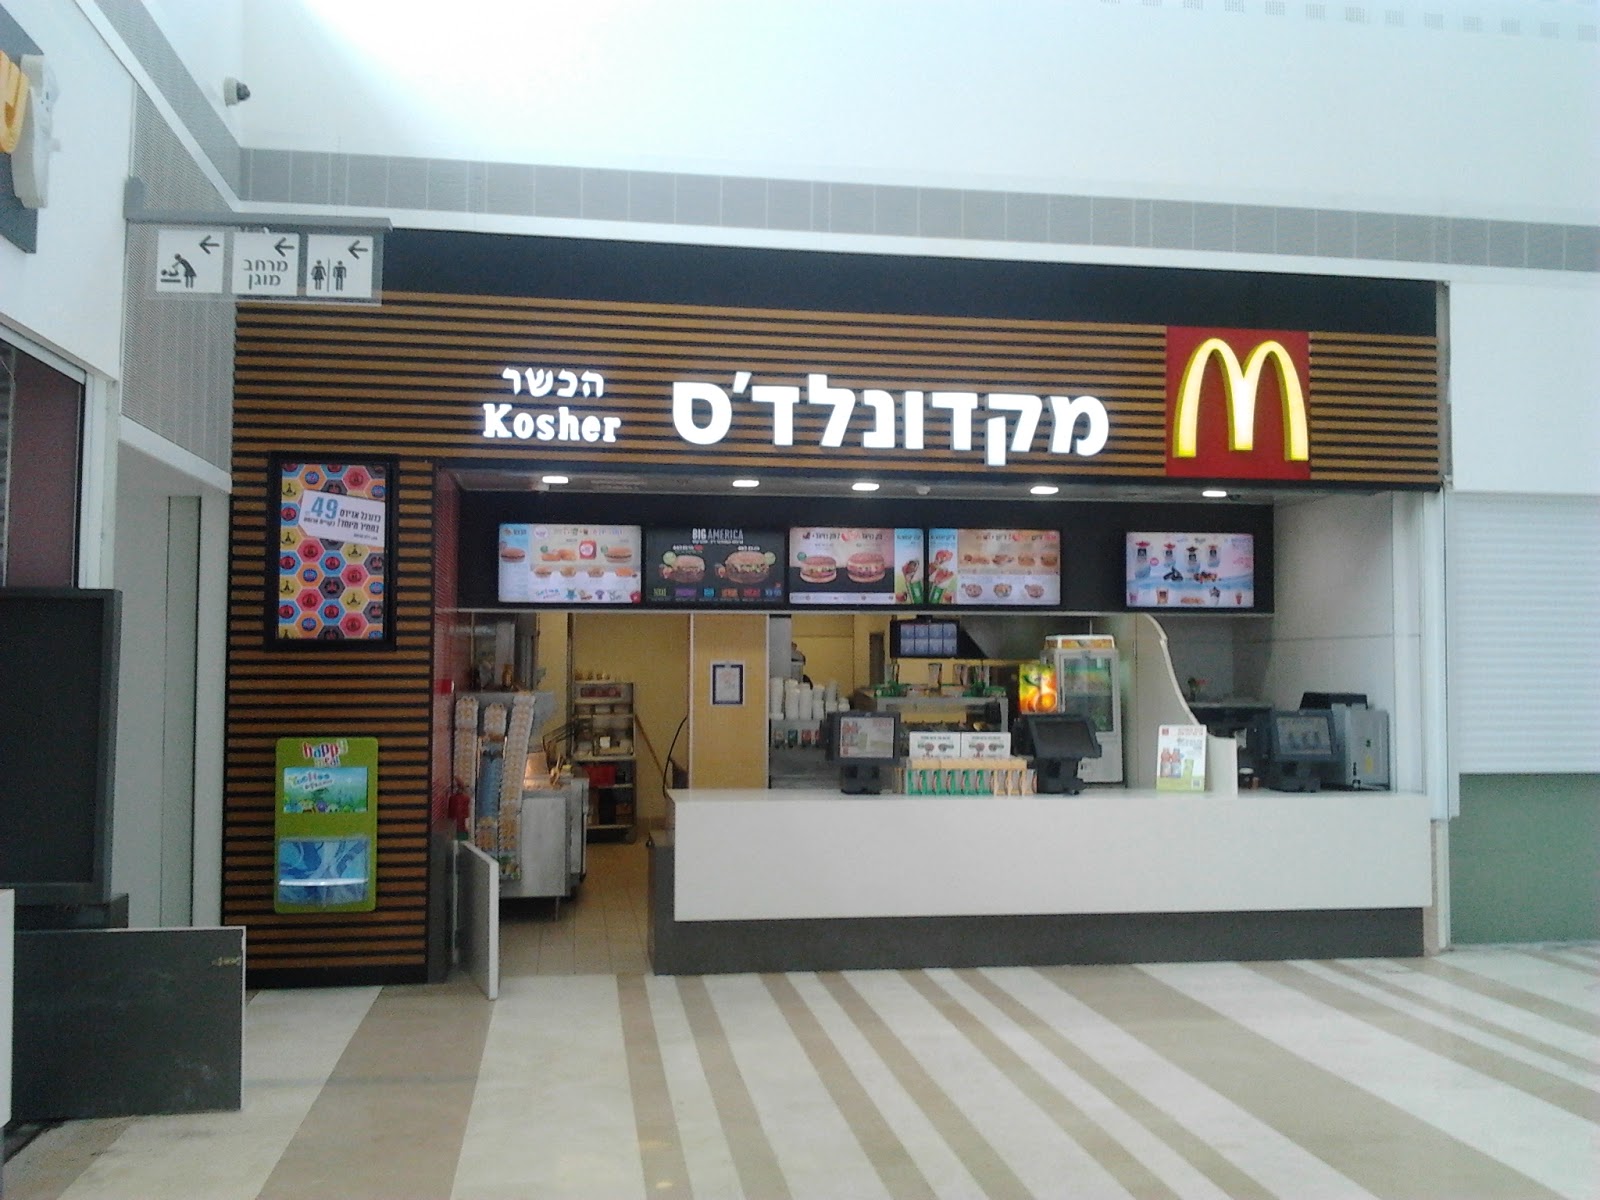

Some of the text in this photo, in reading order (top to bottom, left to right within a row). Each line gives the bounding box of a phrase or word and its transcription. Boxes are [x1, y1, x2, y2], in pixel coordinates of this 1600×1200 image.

[244, 258, 288, 272] מרחב
[248, 273, 281, 290] מוגן
[502, 367, 604, 398] הכשר
[482, 403, 622, 443] Kosher
[672, 371, 1109, 466] מקדונלד'ס
[311, 496, 339, 519] 49
[692, 528, 744, 541] BIG AMERICA
[303, 739, 348, 759] happy
